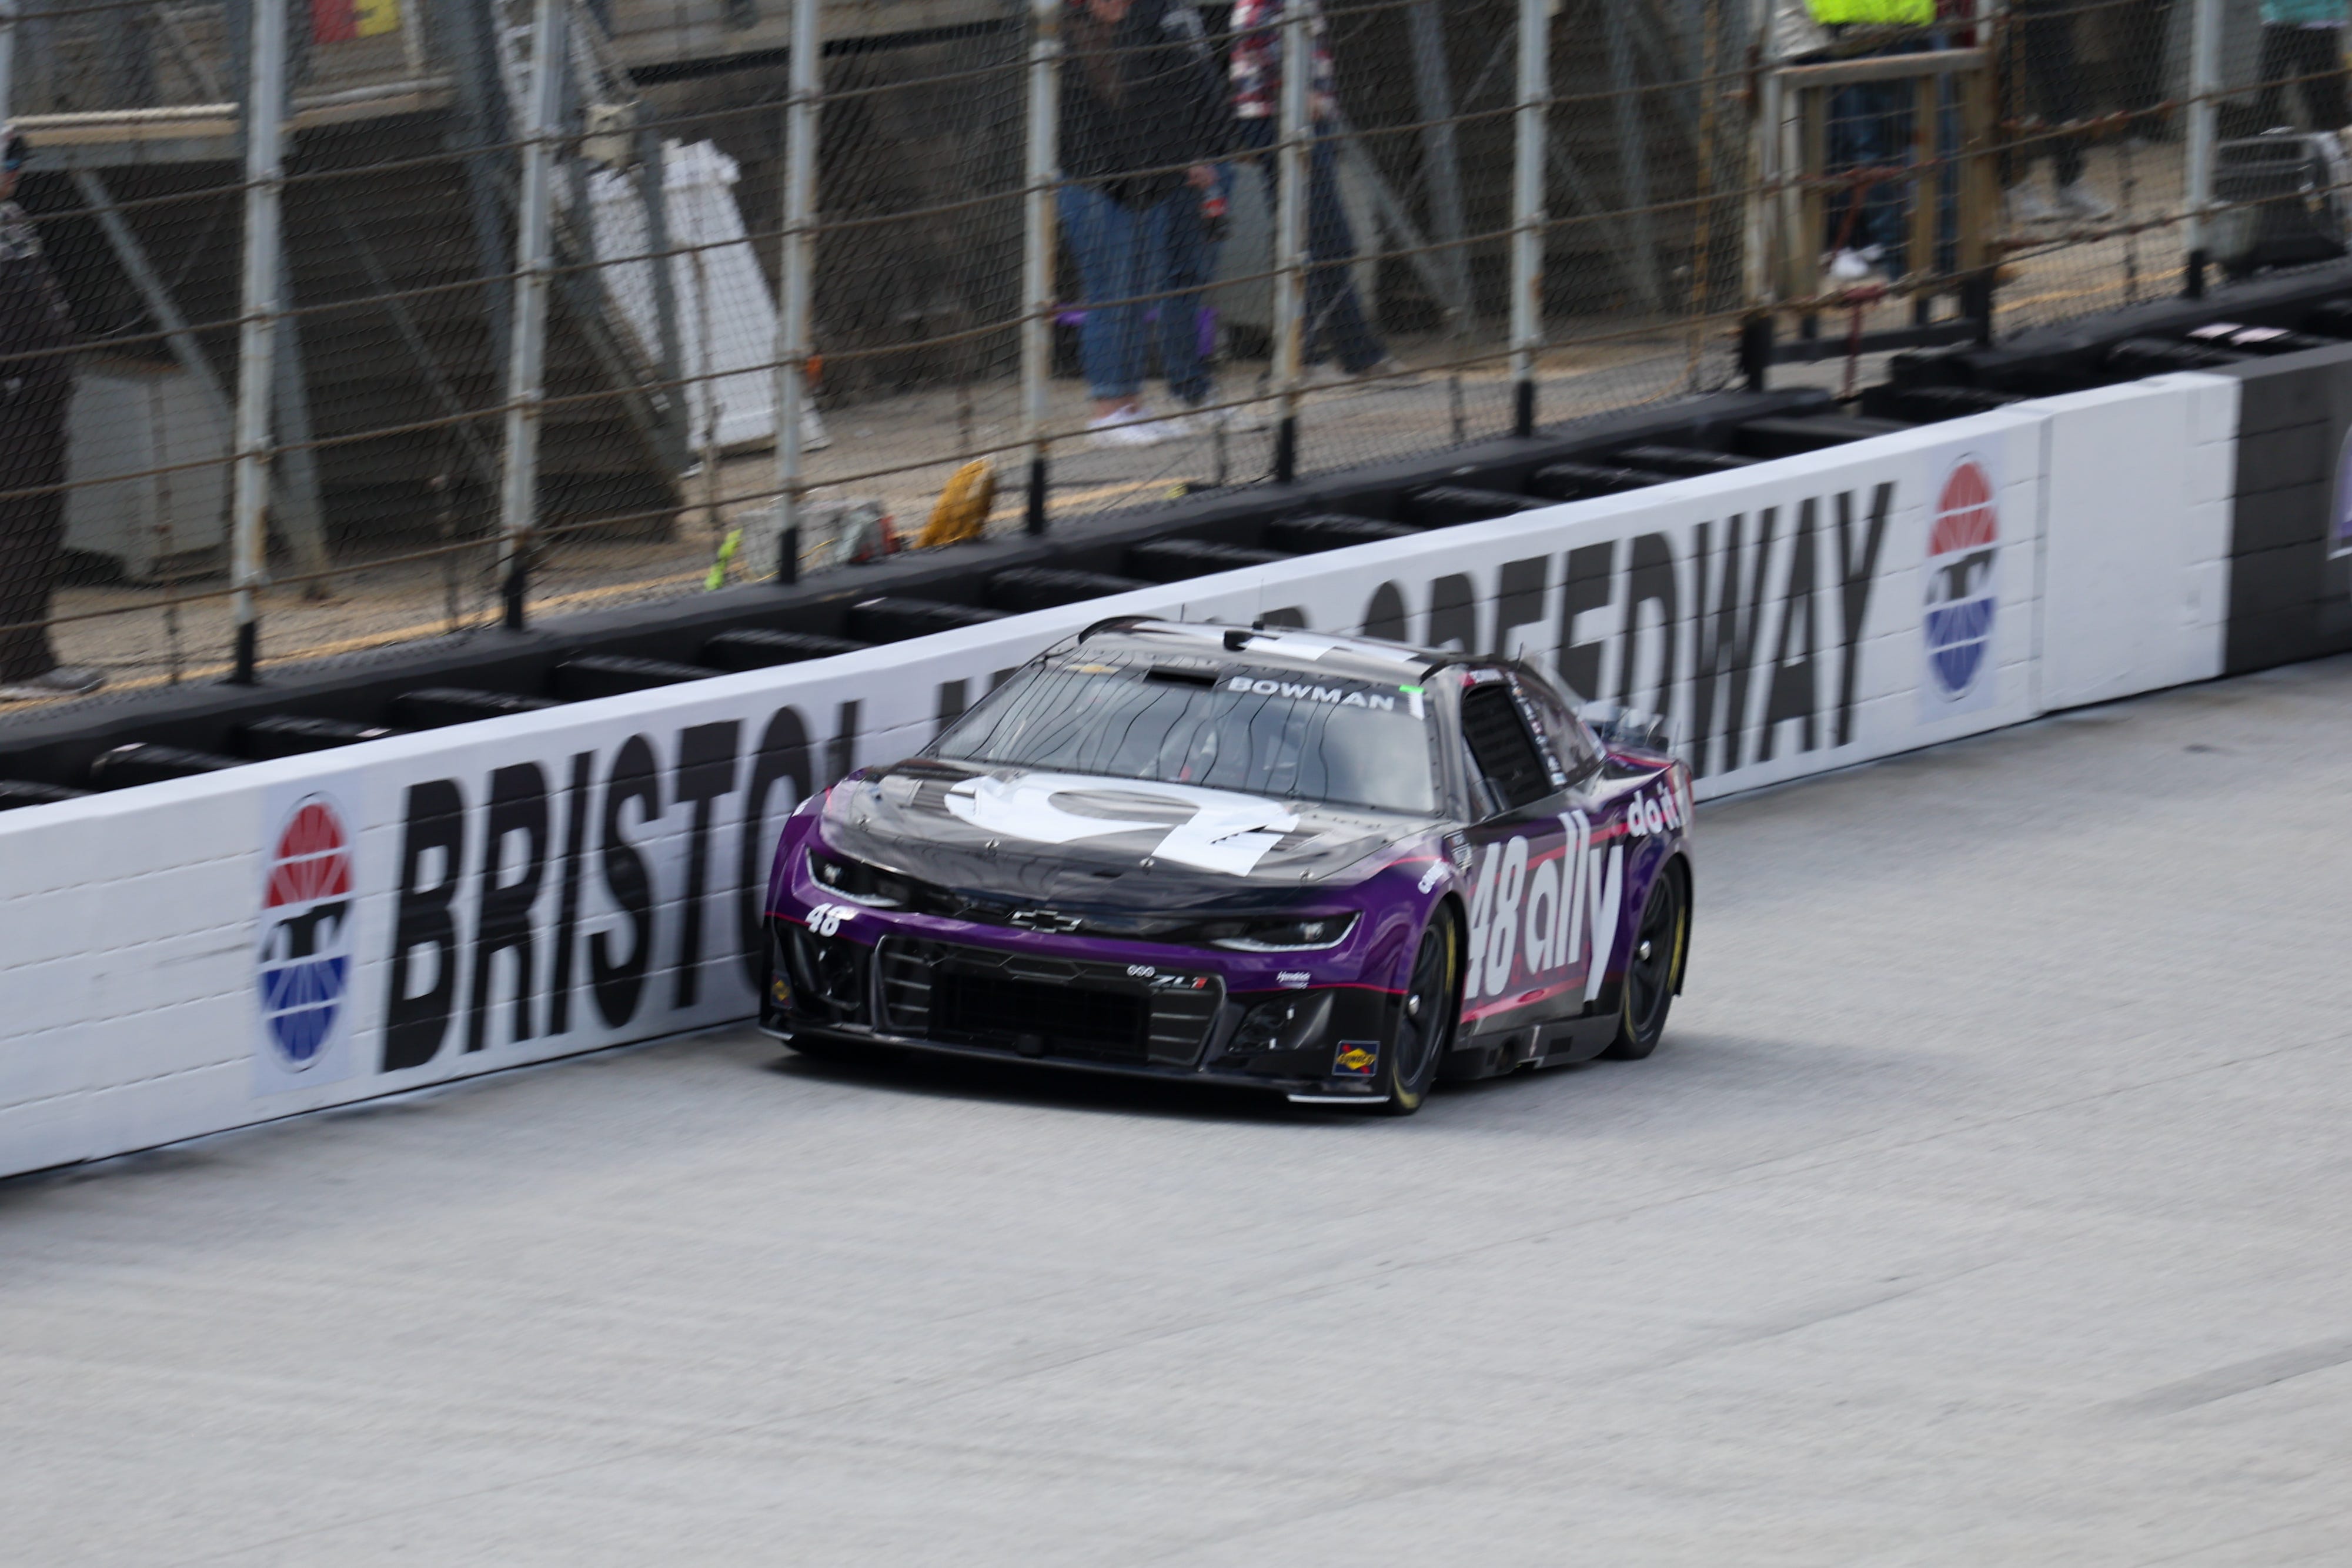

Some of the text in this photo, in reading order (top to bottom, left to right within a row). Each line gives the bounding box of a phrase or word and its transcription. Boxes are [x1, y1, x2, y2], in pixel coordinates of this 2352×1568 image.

[1361, 481, 1896, 780] EDWAY
[1228, 676, 1394, 711] BOWMAN
[1627, 789, 1663, 837] do
[804, 902, 859, 937] 48
[1465, 809, 1623, 1002] 48 ally
[1148, 974, 1208, 989] ZL1
